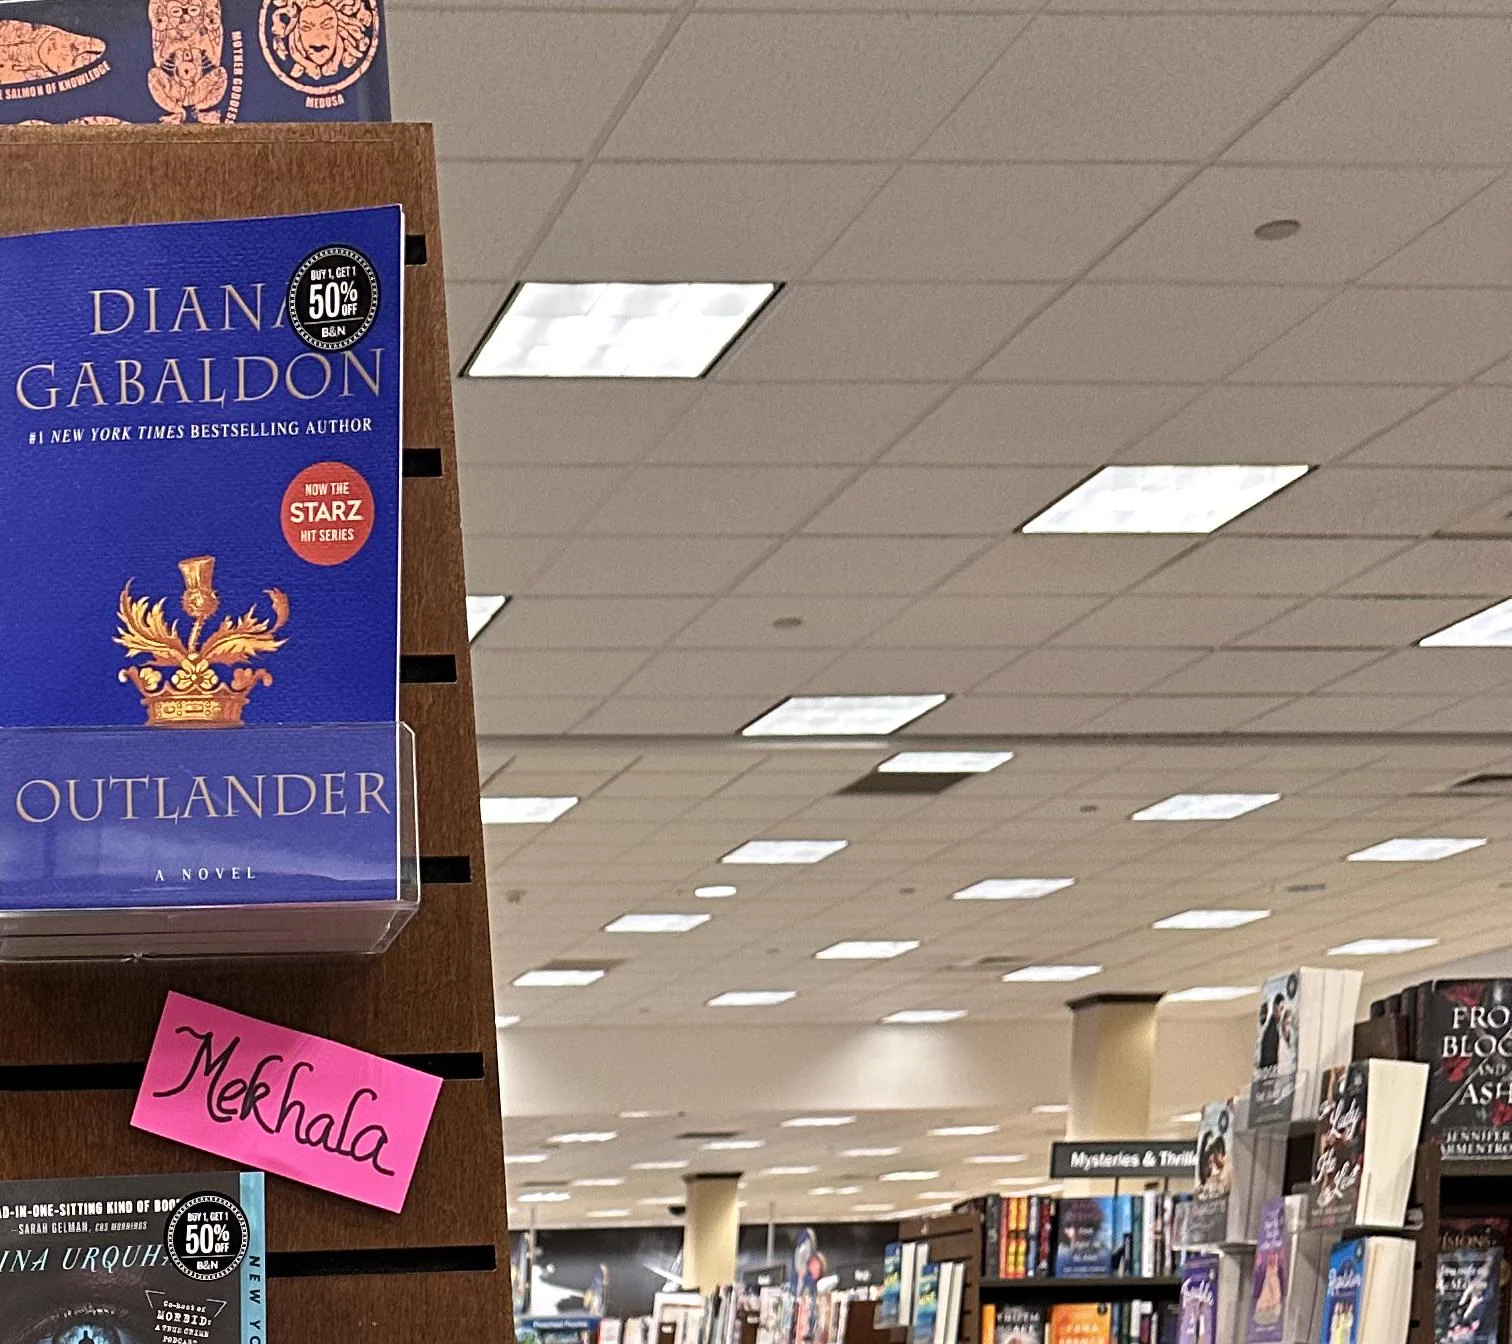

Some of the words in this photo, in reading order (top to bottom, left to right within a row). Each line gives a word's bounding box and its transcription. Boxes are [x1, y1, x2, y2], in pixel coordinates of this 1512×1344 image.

[4, 84, 46, 100] SALMON
[45, 82, 57, 96] OF
[57, 60, 113, 94] KNOWLEDGE
[304, 93, 345, 110] MEDUSA
[308, 280, 358, 320] 50%
[15, 346, 385, 413] GABALDON
[28, 430, 45, 446] #1
[50, 427, 85, 444] NEW
[89, 425, 132, 443] YORK
[136, 424, 186, 441] TIMES
[189, 420, 301, 440] BESTSELLING
[305, 417, 373, 436] AUTHOR
[304, 482, 328, 497] NOW
[330, 481, 350, 496] THE
[289, 500, 363, 524] STARZ
[299, 529, 317, 543] HIT
[318, 528, 355, 543] SERIES
[15, 770, 391, 825] OUTLANDER
[154, 868, 165, 883] A
[180, 866, 257, 882] NOVEL
[152, 1025, 395, 1177] Mekhala
[1070, 1150, 1139, 1170] Mysteries
[1143, 1151, 1156, 1168] &
[248, 1254, 262, 1306] NEW
